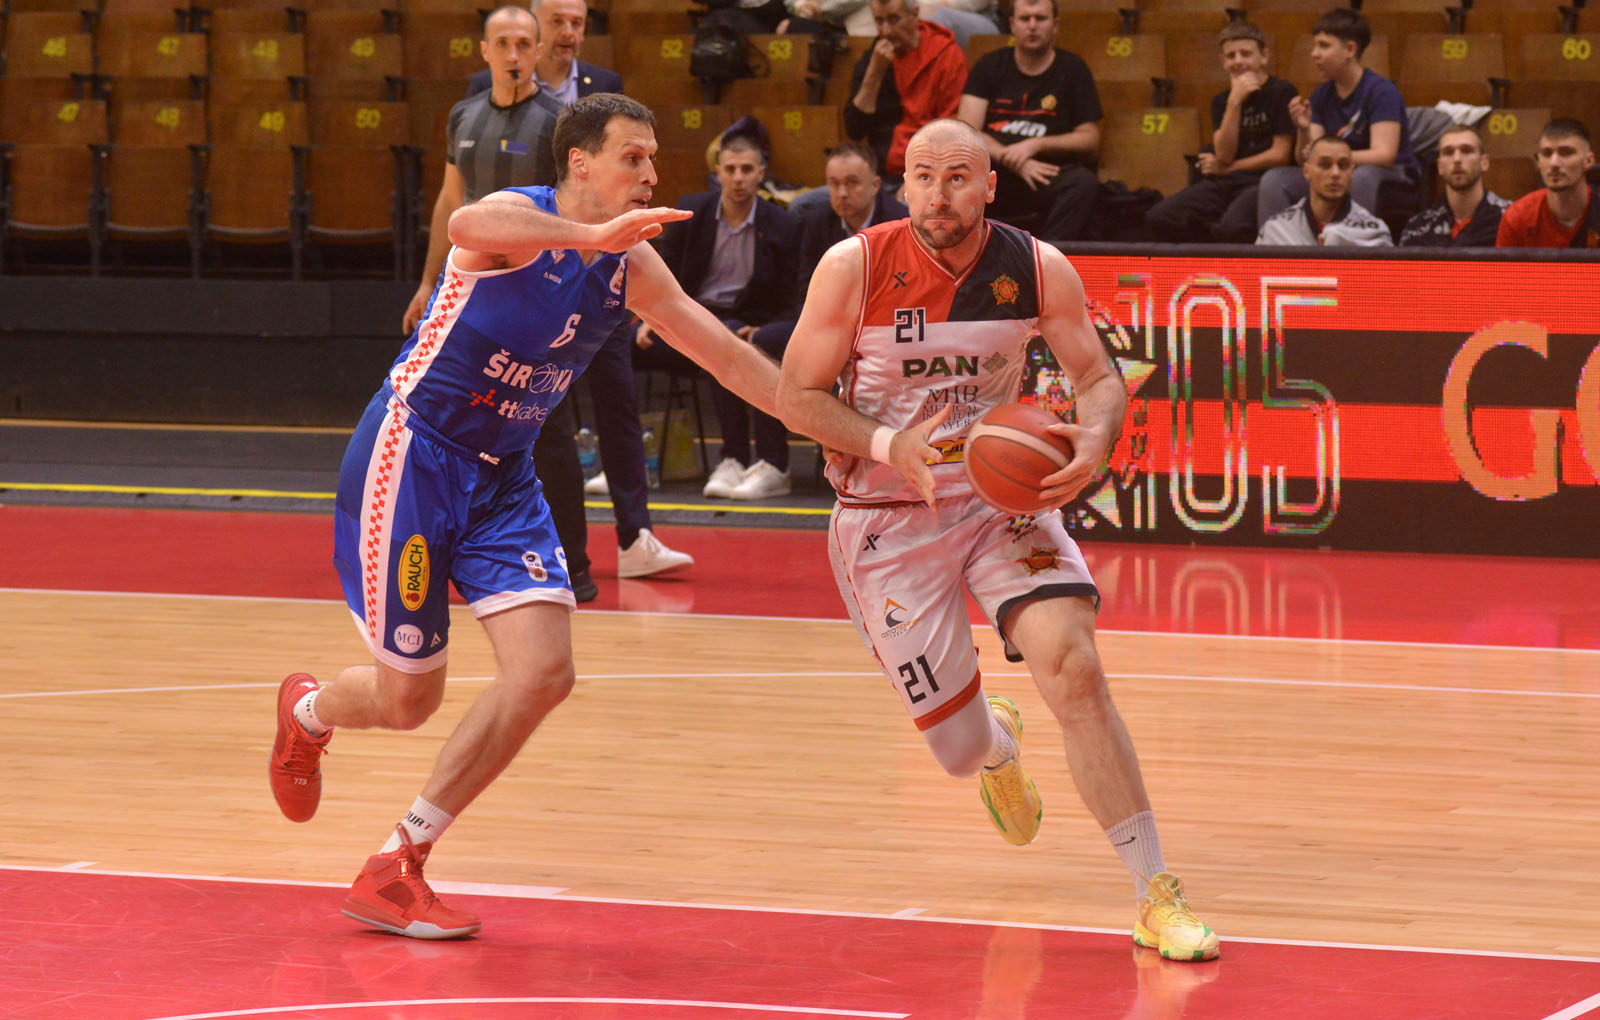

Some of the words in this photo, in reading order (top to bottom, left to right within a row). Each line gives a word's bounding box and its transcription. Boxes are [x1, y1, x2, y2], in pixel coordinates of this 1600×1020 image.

[1107, 37, 1133, 58] 56
[1562, 38, 1592, 61] 60
[259, 111, 285, 132] 49
[355, 108, 382, 129] 50
[1142, 113, 1170, 135] 57
[1488, 114, 1518, 135] 60
[549, 314, 582, 348] 6
[894, 307, 926, 343] 21
[902, 355, 979, 378] PAN
[926, 385, 979, 403] MIB
[923, 402, 979, 413] MEICAL
[1443, 320, 1600, 501] G
[936, 418, 971, 431] AYER
[407, 543, 424, 592] RAUCH
[397, 631, 421, 646] MCI
[898, 655, 940, 705] 21
